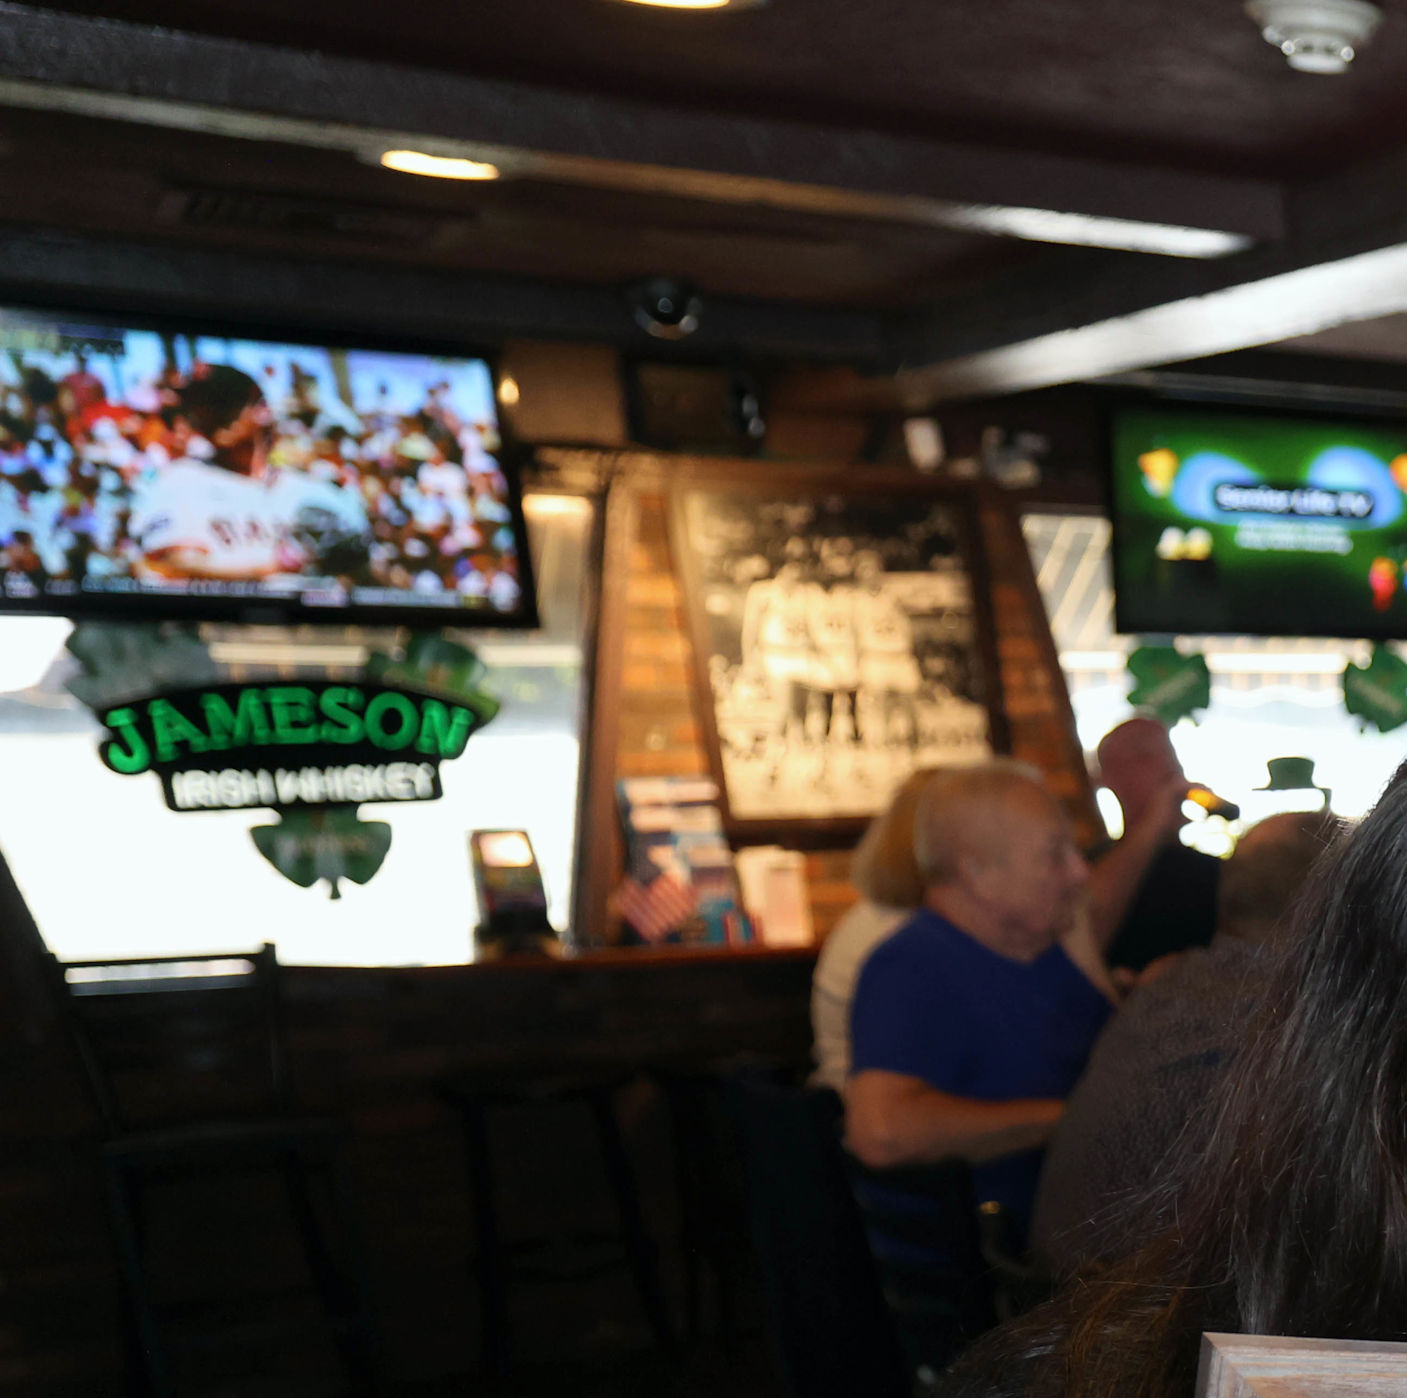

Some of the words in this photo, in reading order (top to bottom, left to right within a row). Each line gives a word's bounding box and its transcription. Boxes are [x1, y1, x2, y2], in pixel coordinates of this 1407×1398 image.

[106, 686, 475, 774] JAMESON
[171, 767, 275, 809] IRISH
[276, 762, 435, 804] WHISKEY
